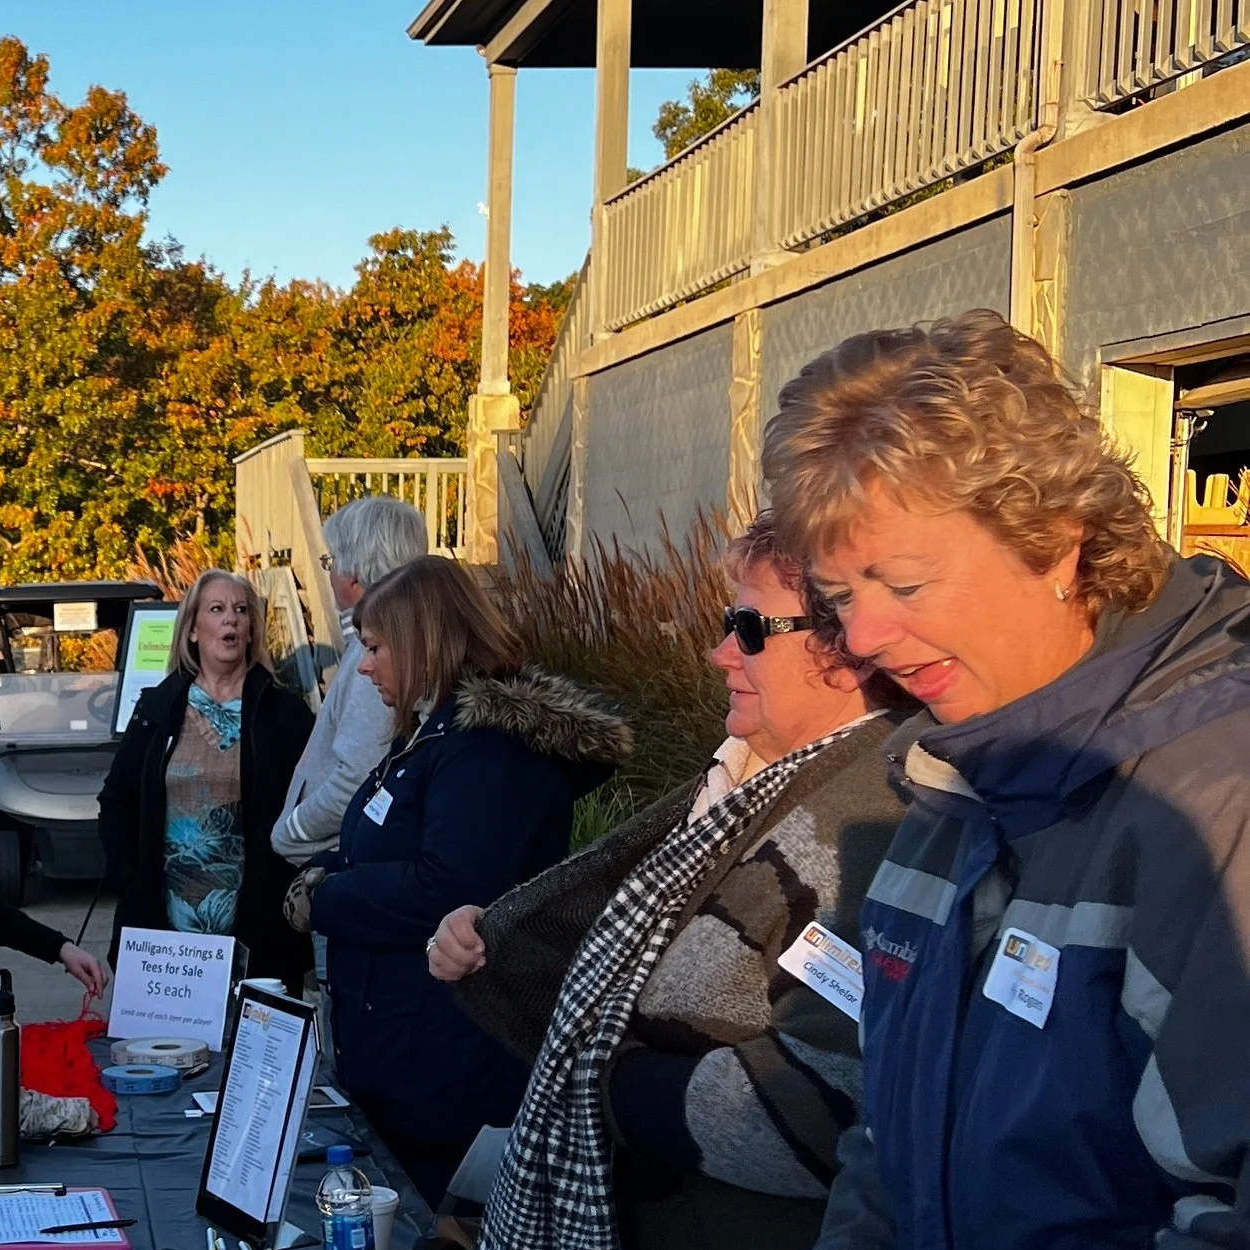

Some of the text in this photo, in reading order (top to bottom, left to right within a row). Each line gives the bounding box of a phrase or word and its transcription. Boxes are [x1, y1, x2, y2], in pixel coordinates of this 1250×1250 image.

[125, 940, 225, 961] Mulligans, Strings &
[141, 960, 203, 978] Tees for Sale
[803, 961, 829, 983] Cindy
[146, 980, 192, 998] $5 each
